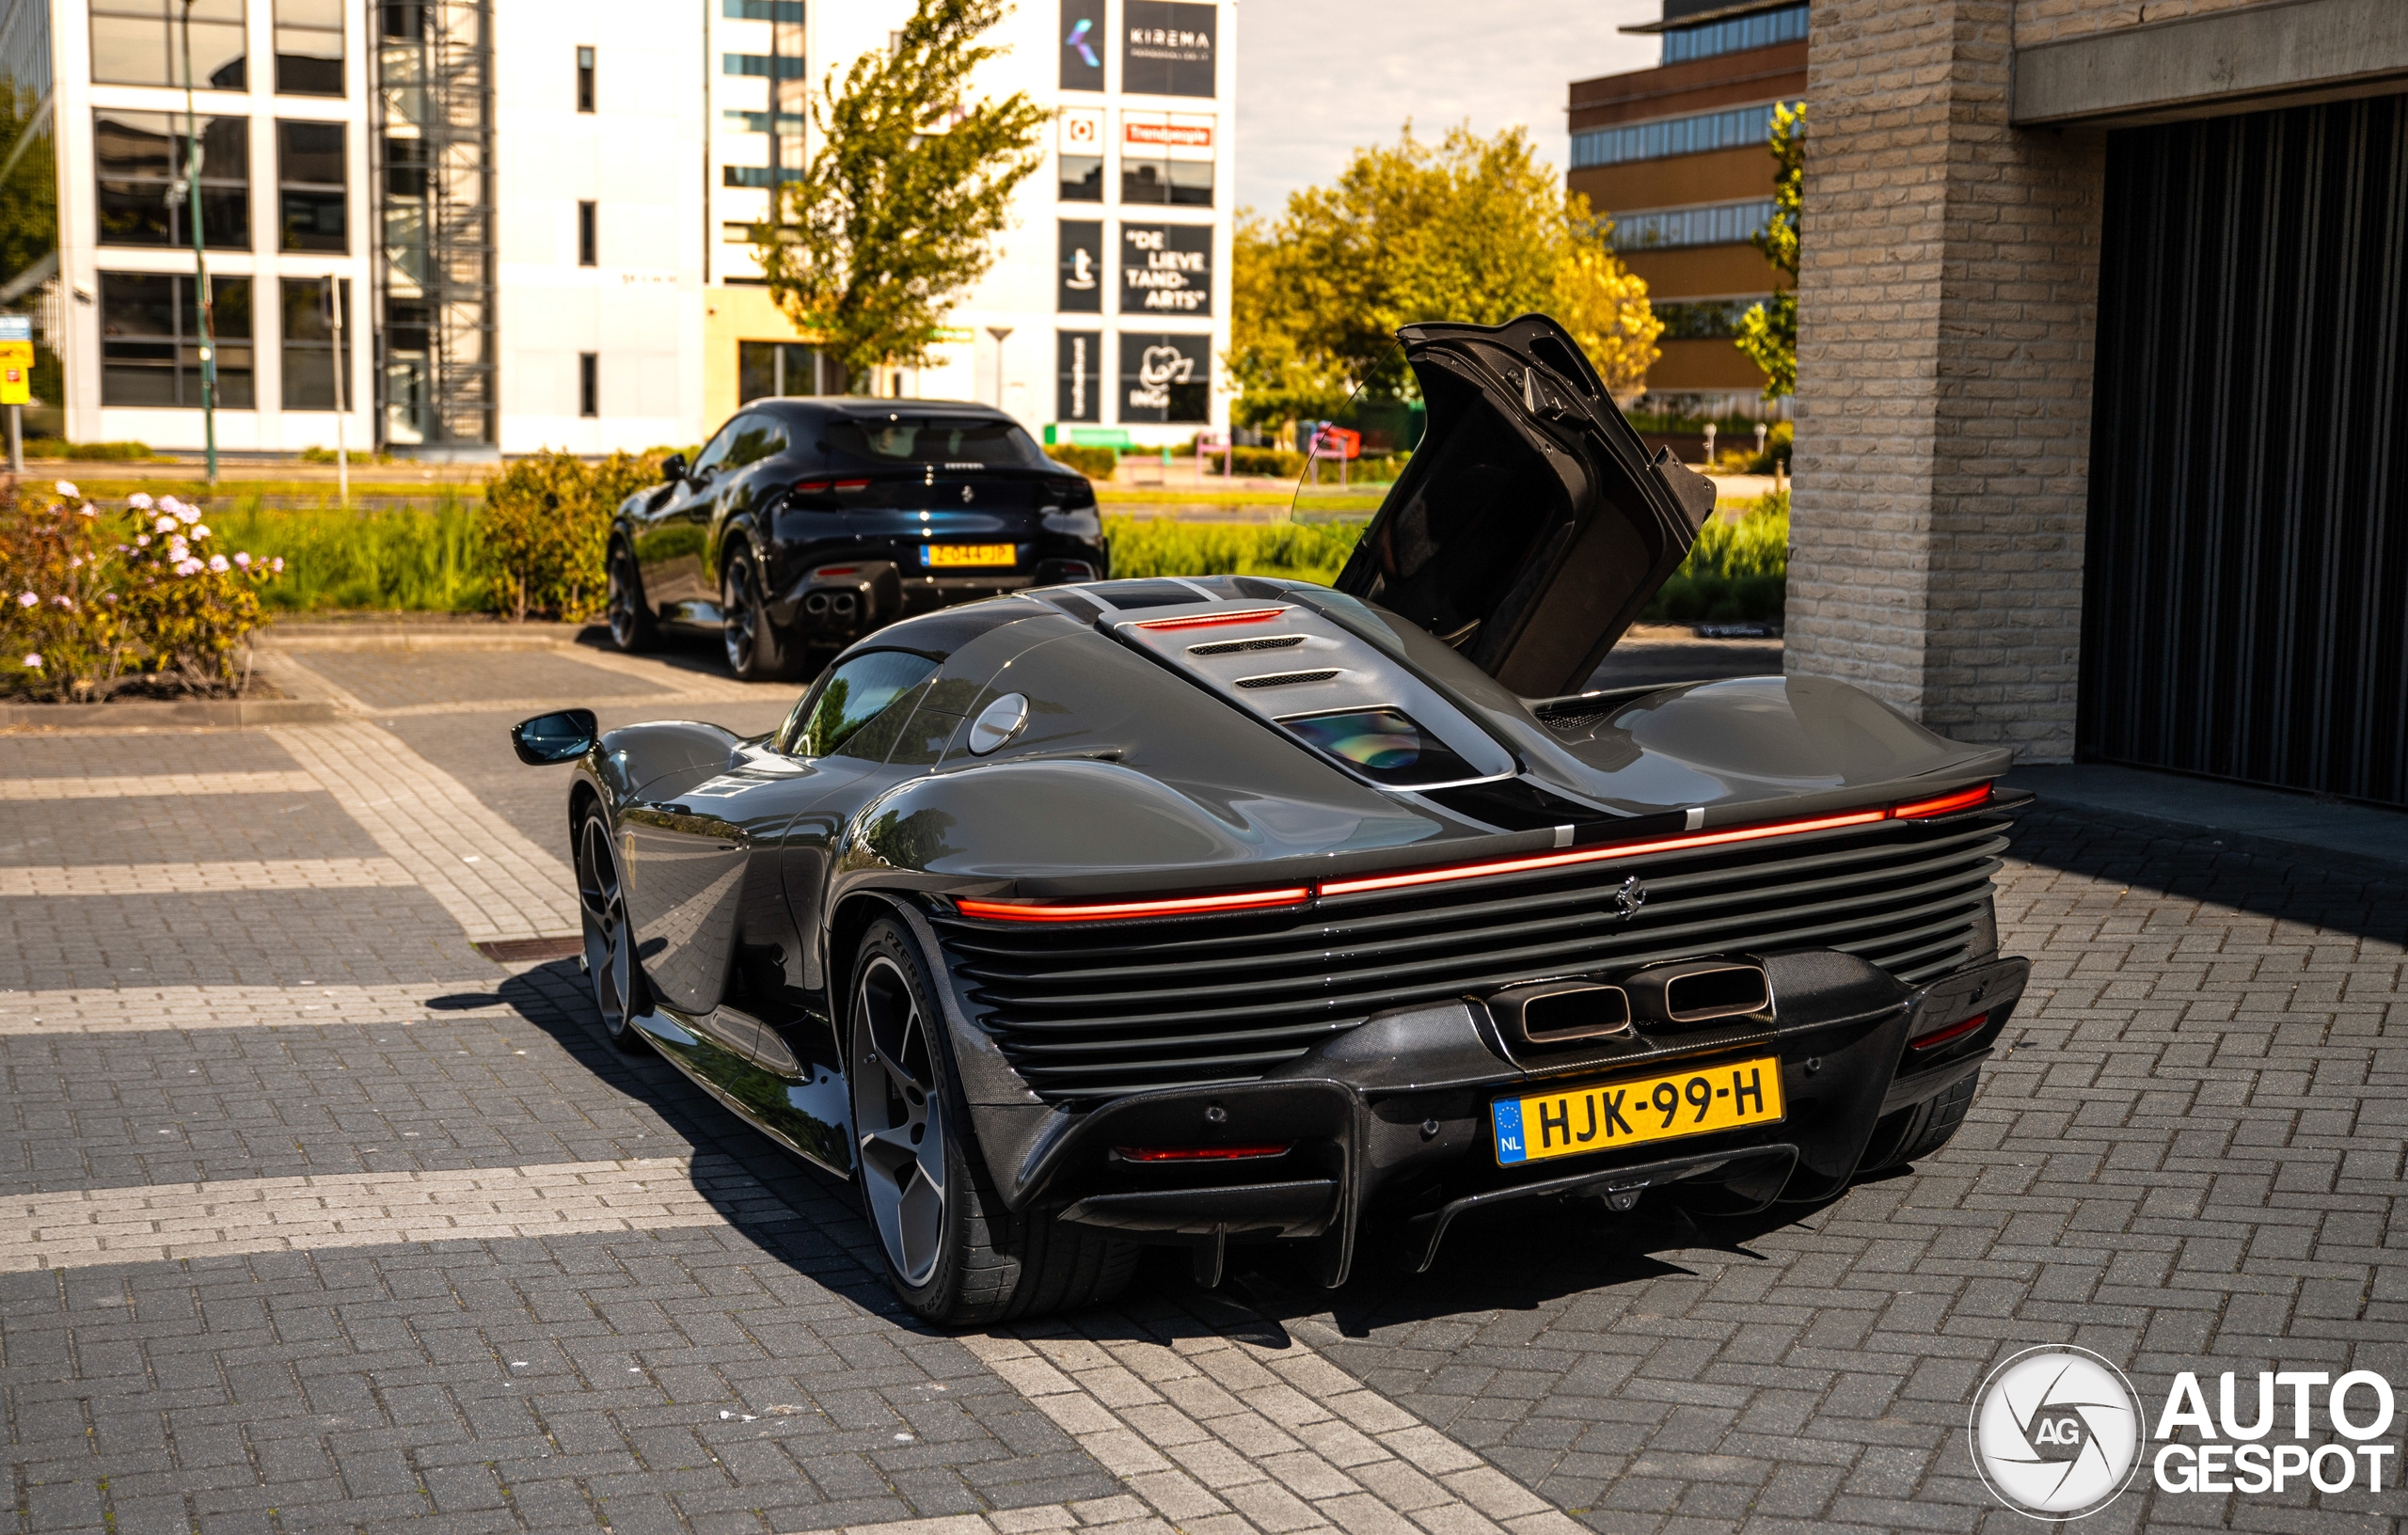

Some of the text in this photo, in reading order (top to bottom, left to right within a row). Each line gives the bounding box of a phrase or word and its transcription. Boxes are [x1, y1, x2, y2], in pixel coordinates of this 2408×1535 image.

[1130, 28, 1210, 48] KIREMA
[1148, 251, 1205, 270] LIEVE
[1126, 269, 1190, 288] TAND-
[1539, 1068, 1764, 1148] HJK-99-H
[1501, 1136, 1522, 1152] NL
